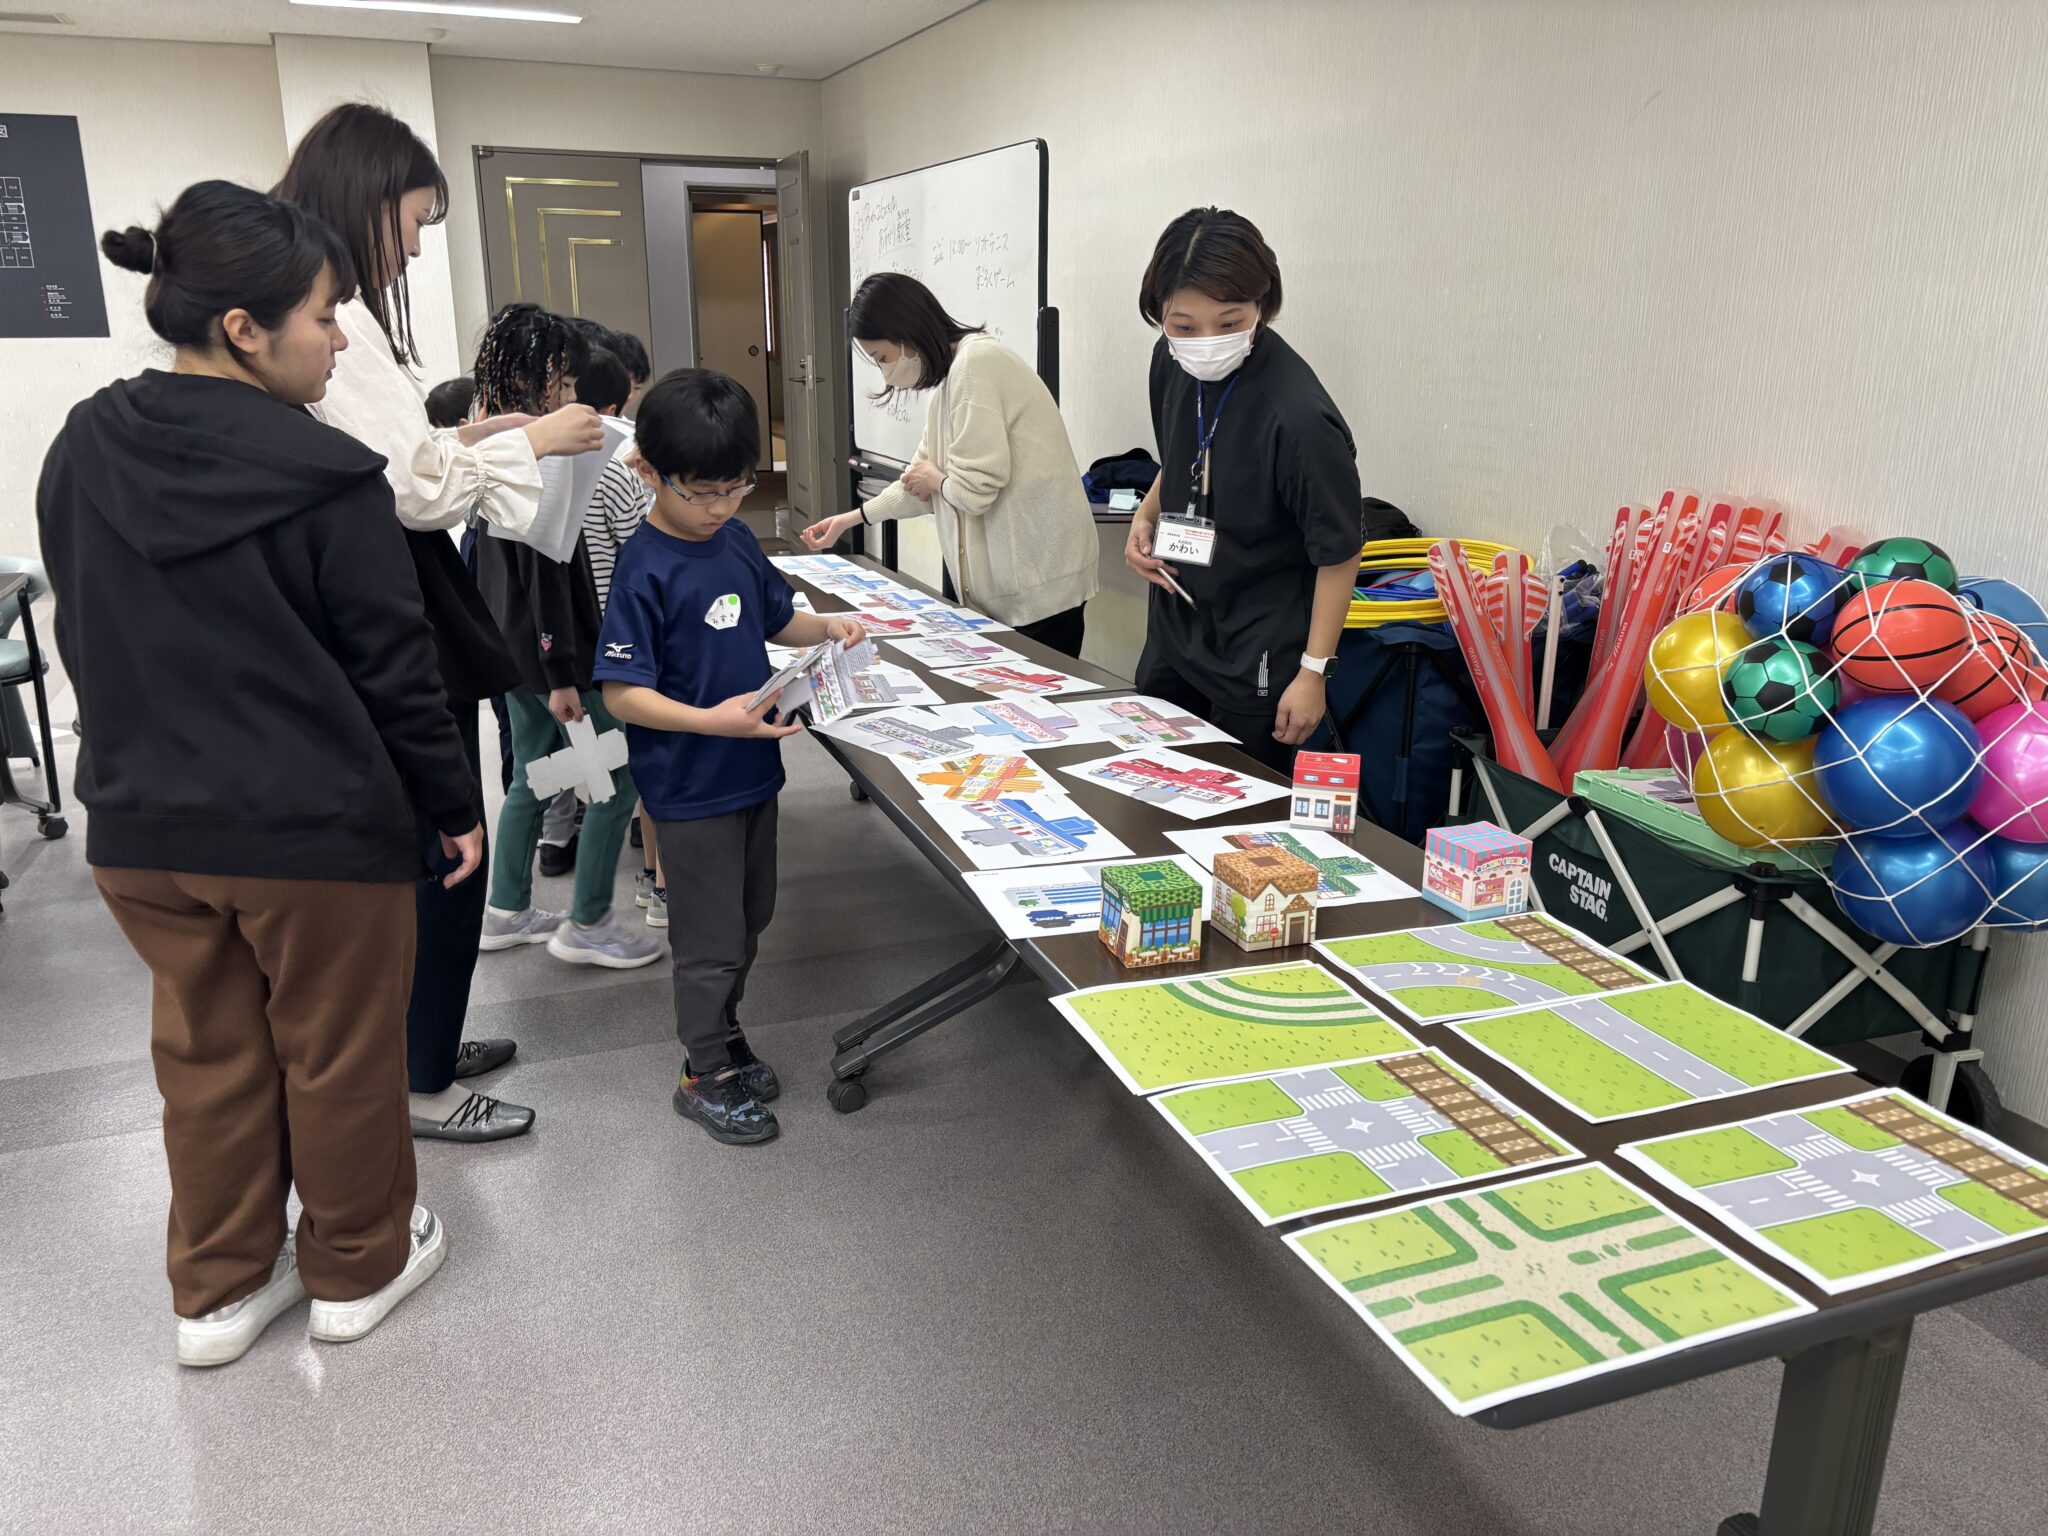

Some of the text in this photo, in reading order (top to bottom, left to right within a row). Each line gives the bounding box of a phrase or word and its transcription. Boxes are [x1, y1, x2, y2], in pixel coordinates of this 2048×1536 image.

[1168, 542, 1199, 555] かわい
[1548, 852, 1612, 901] CAPTAIN
[1569, 884, 1608, 920] STAG
